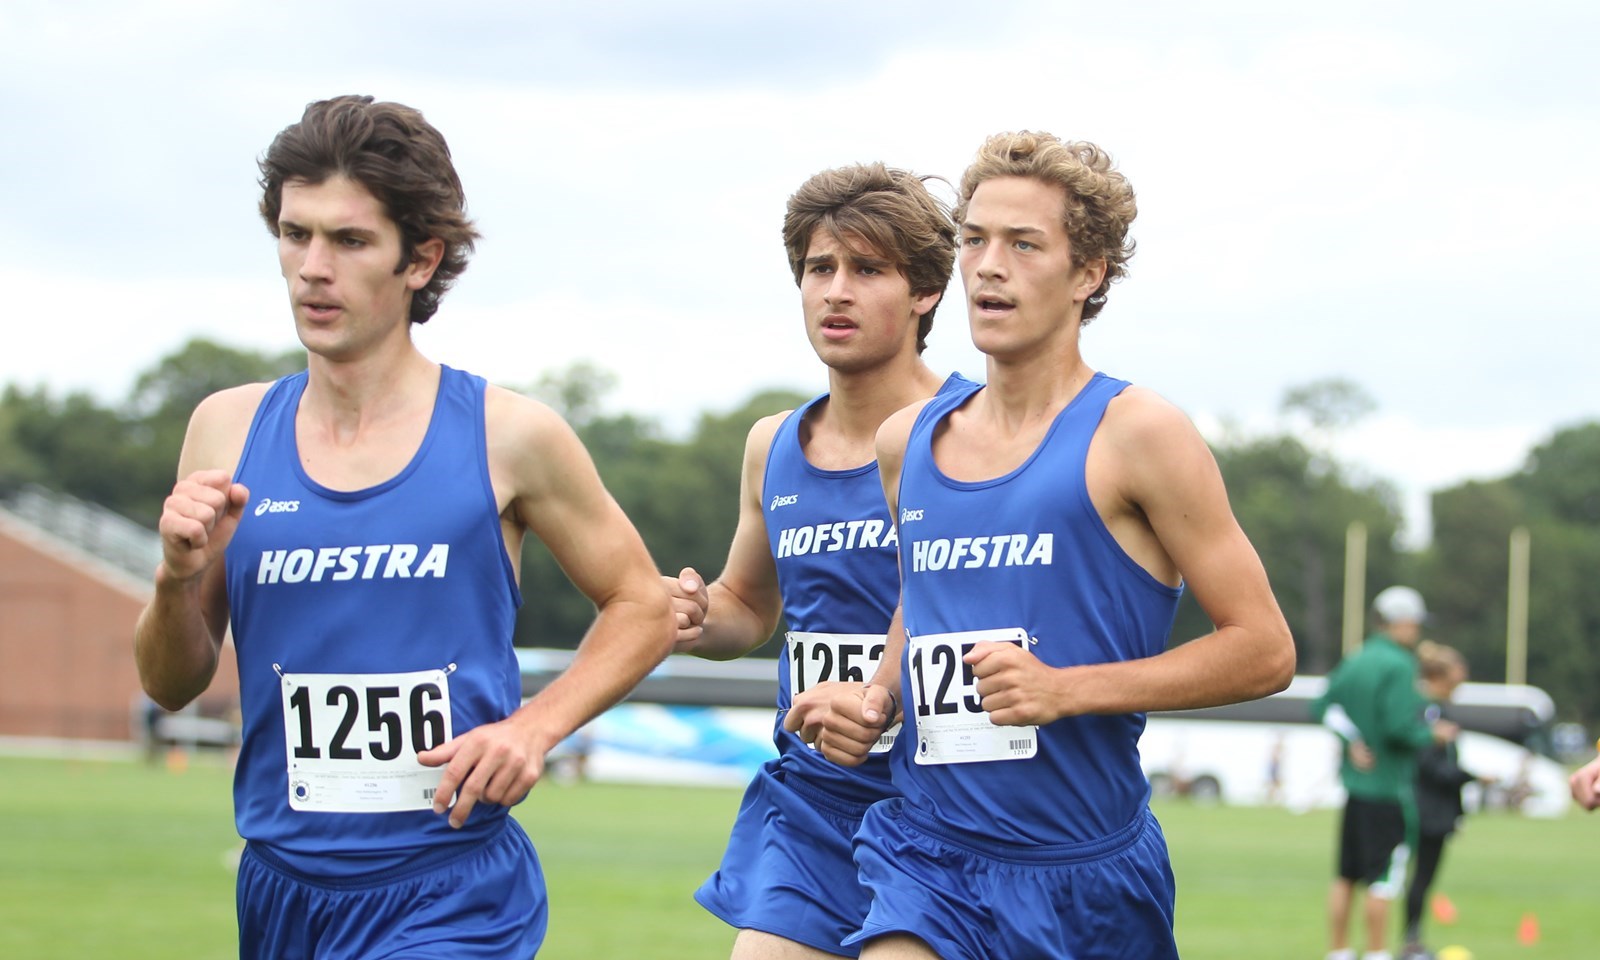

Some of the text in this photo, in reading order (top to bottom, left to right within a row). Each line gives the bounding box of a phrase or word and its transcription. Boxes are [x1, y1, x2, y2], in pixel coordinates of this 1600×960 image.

[268, 500, 300, 513] asics
[777, 519, 899, 559] HOFSTRA
[912, 533, 1054, 573] HOFSTRA
[256, 543, 450, 585] HOFSTRA
[793, 641, 887, 697] 125
[912, 639, 1023, 717] 125
[290, 682, 446, 761] 1256
